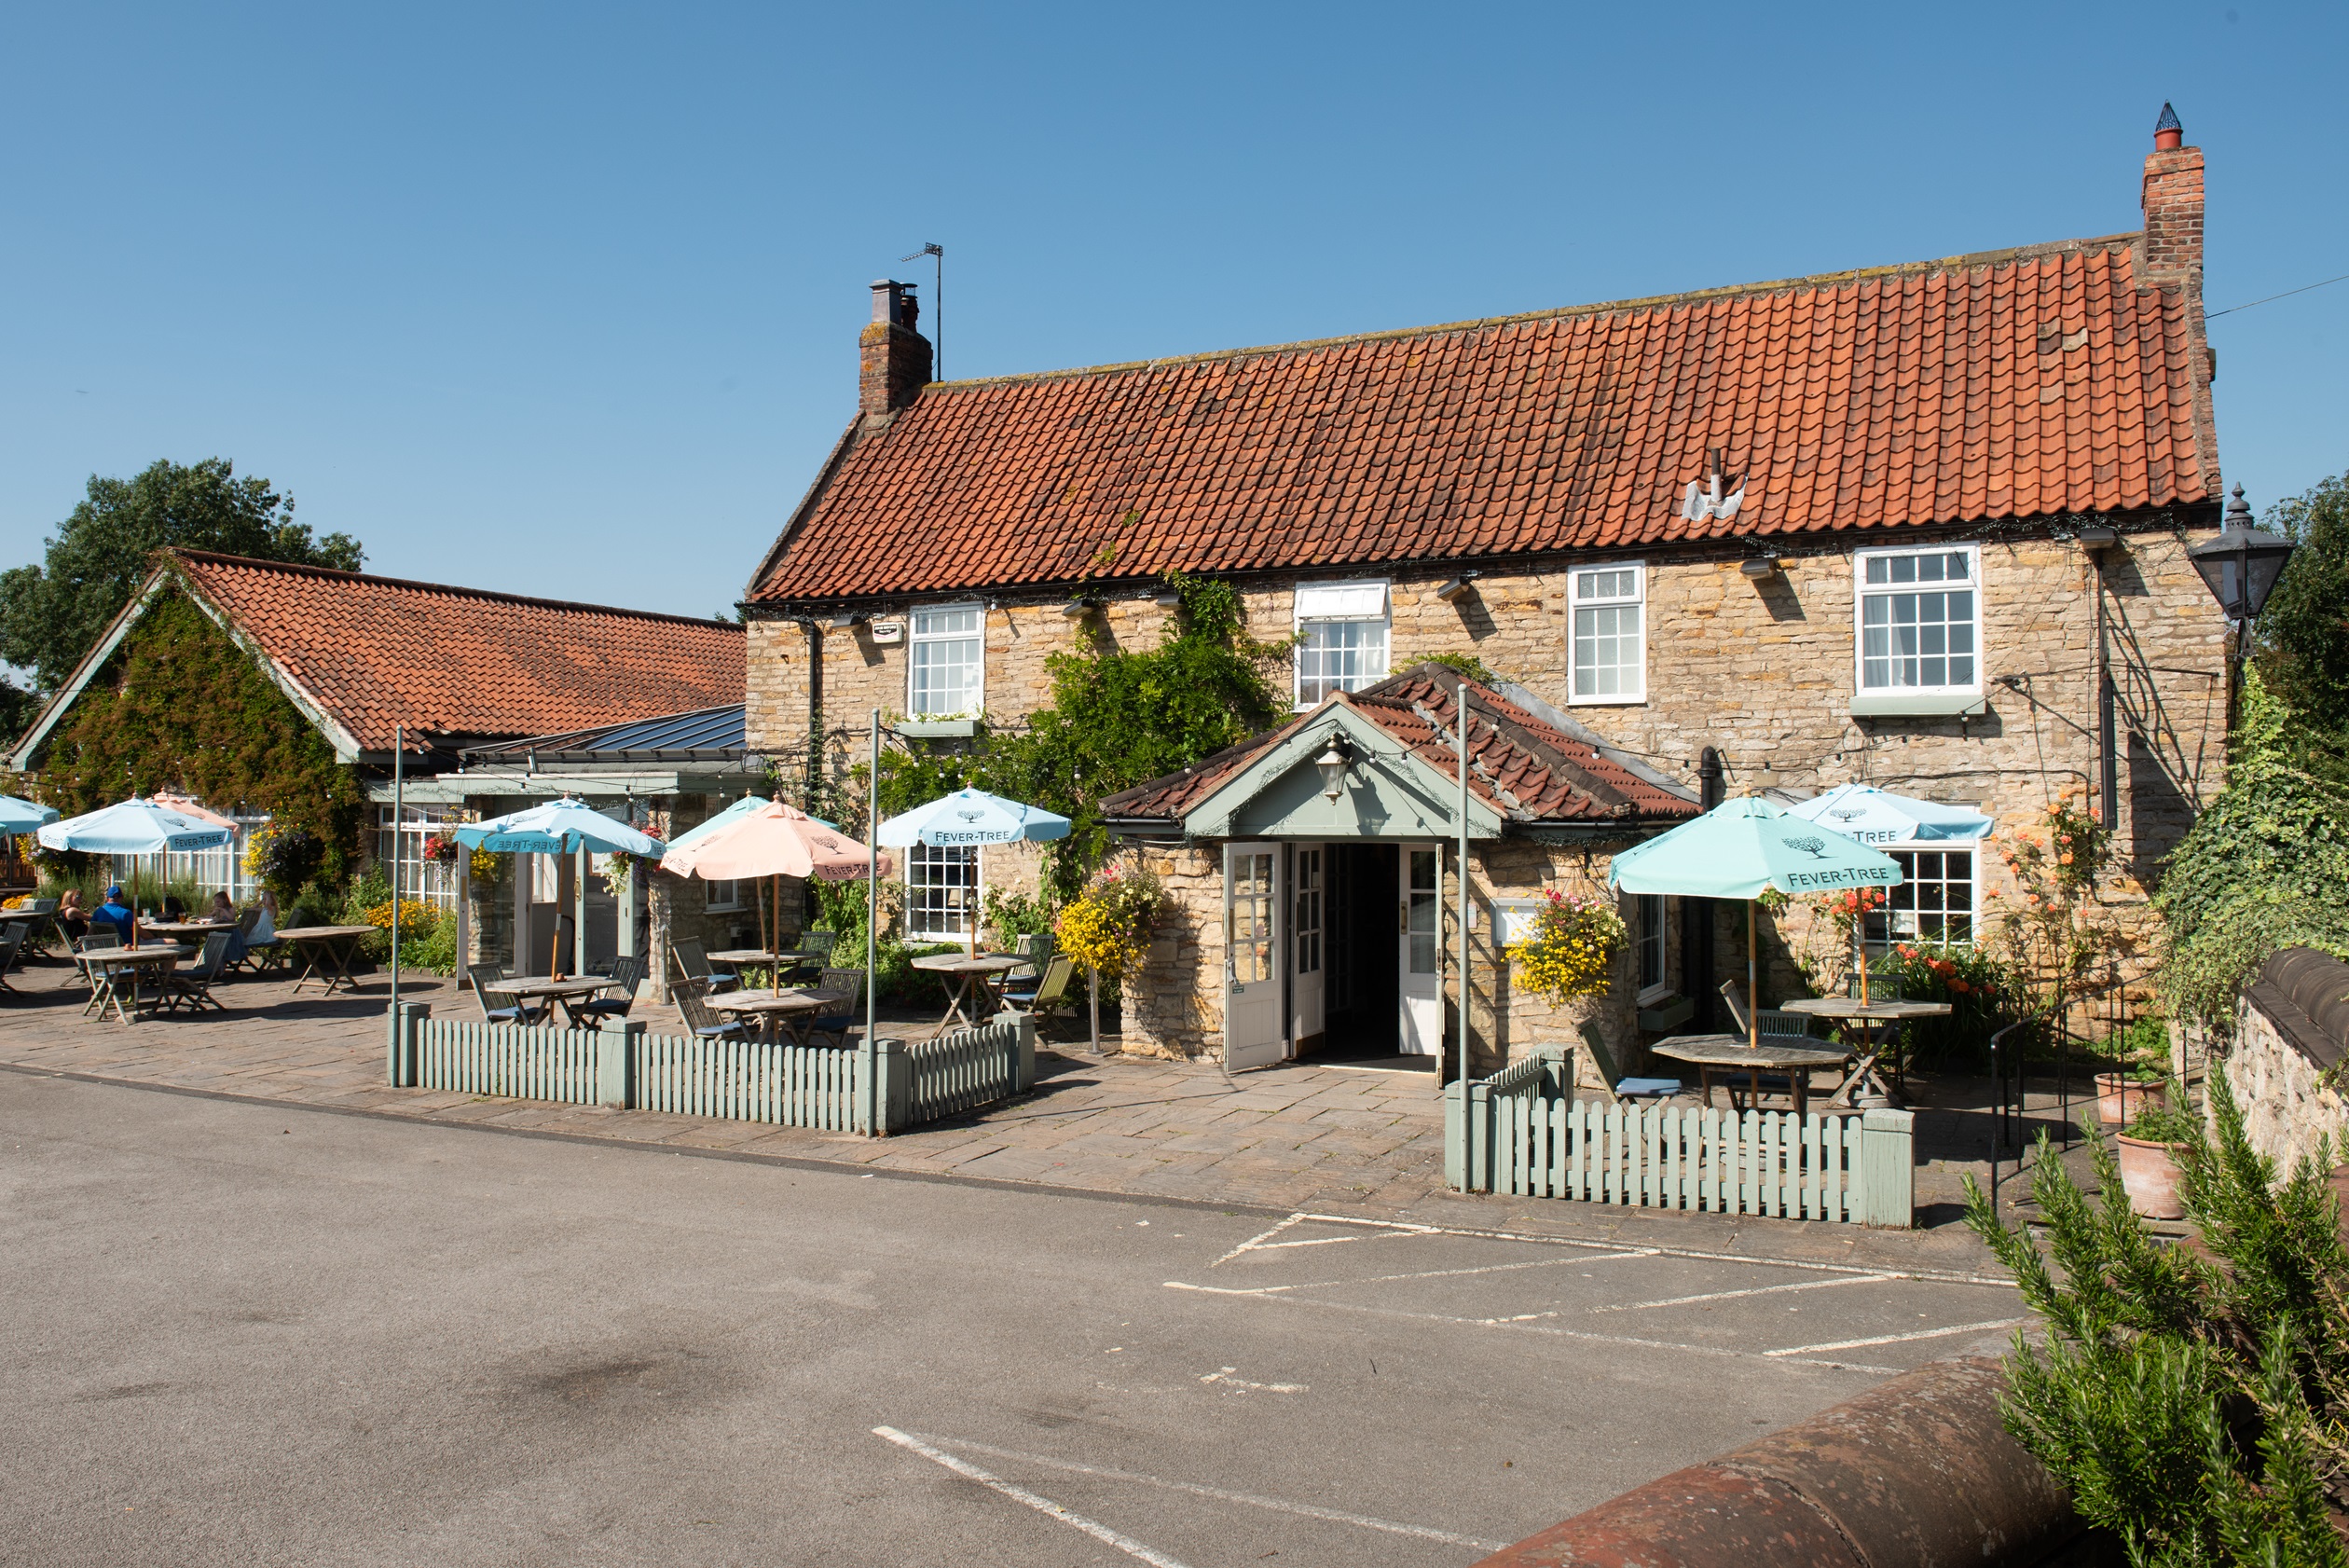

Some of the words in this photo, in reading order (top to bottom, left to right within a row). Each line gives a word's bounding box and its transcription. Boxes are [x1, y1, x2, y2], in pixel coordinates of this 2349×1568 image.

[174, 834, 224, 847] FEVER-TREE
[935, 831, 1010, 842] FEVER-TREE
[1842, 831, 1896, 843] -TREE
[824, 862, 882, 875] FEVER-TRE
[1787, 868, 1889, 887] FEVER-TREE
